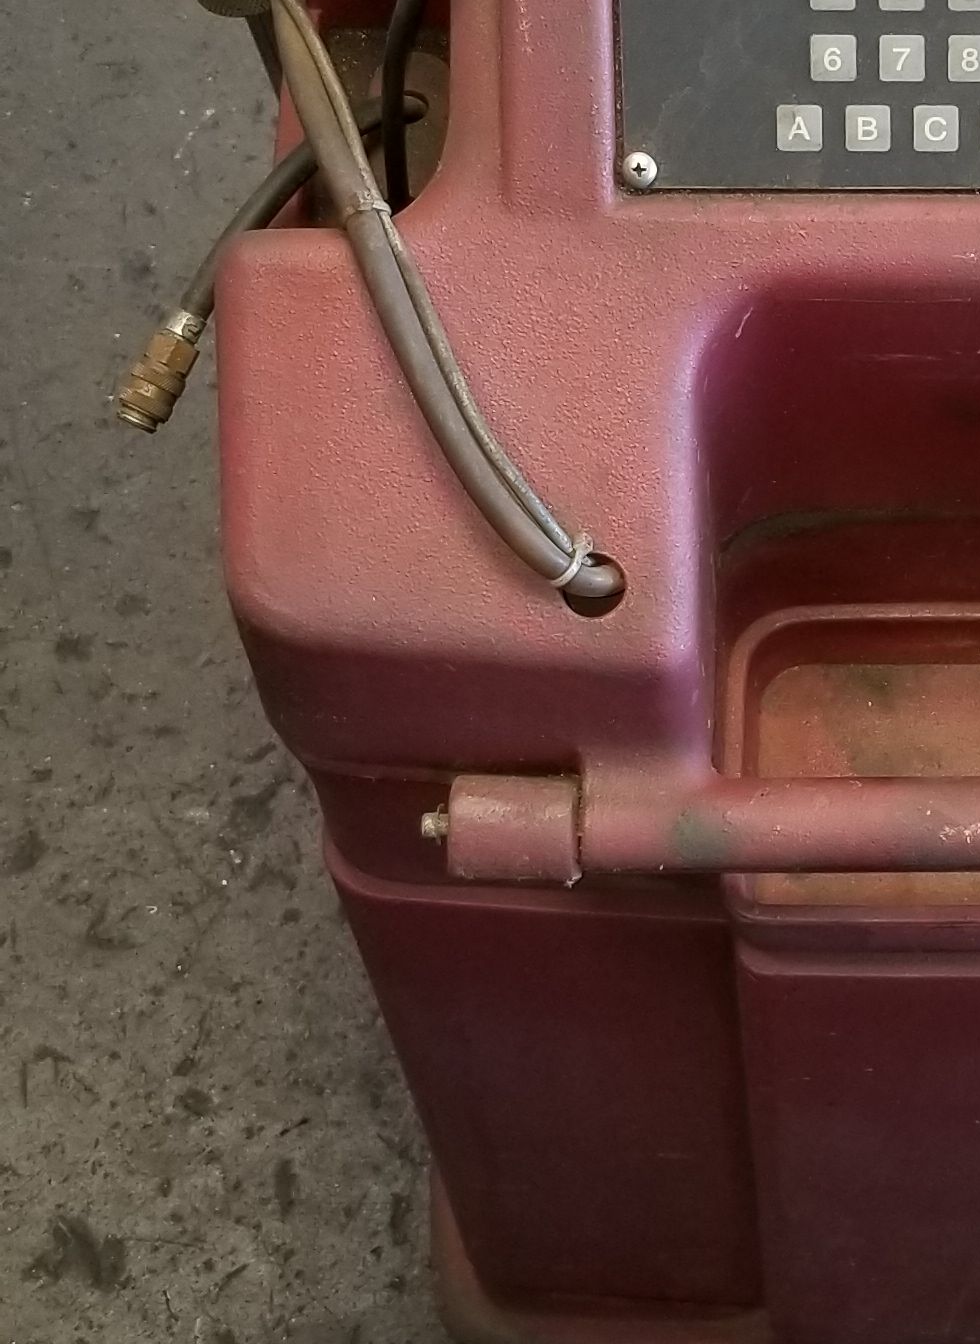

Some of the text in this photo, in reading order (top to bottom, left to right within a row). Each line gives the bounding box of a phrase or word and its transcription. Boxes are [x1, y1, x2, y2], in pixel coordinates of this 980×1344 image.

[823, 48, 842, 70] 6
[892, 48, 912, 70] 7
[960, 48, 980, 71] 8
[787, 117, 810, 140] A
[857, 117, 878, 140] B
[924, 117, 947, 140] C
